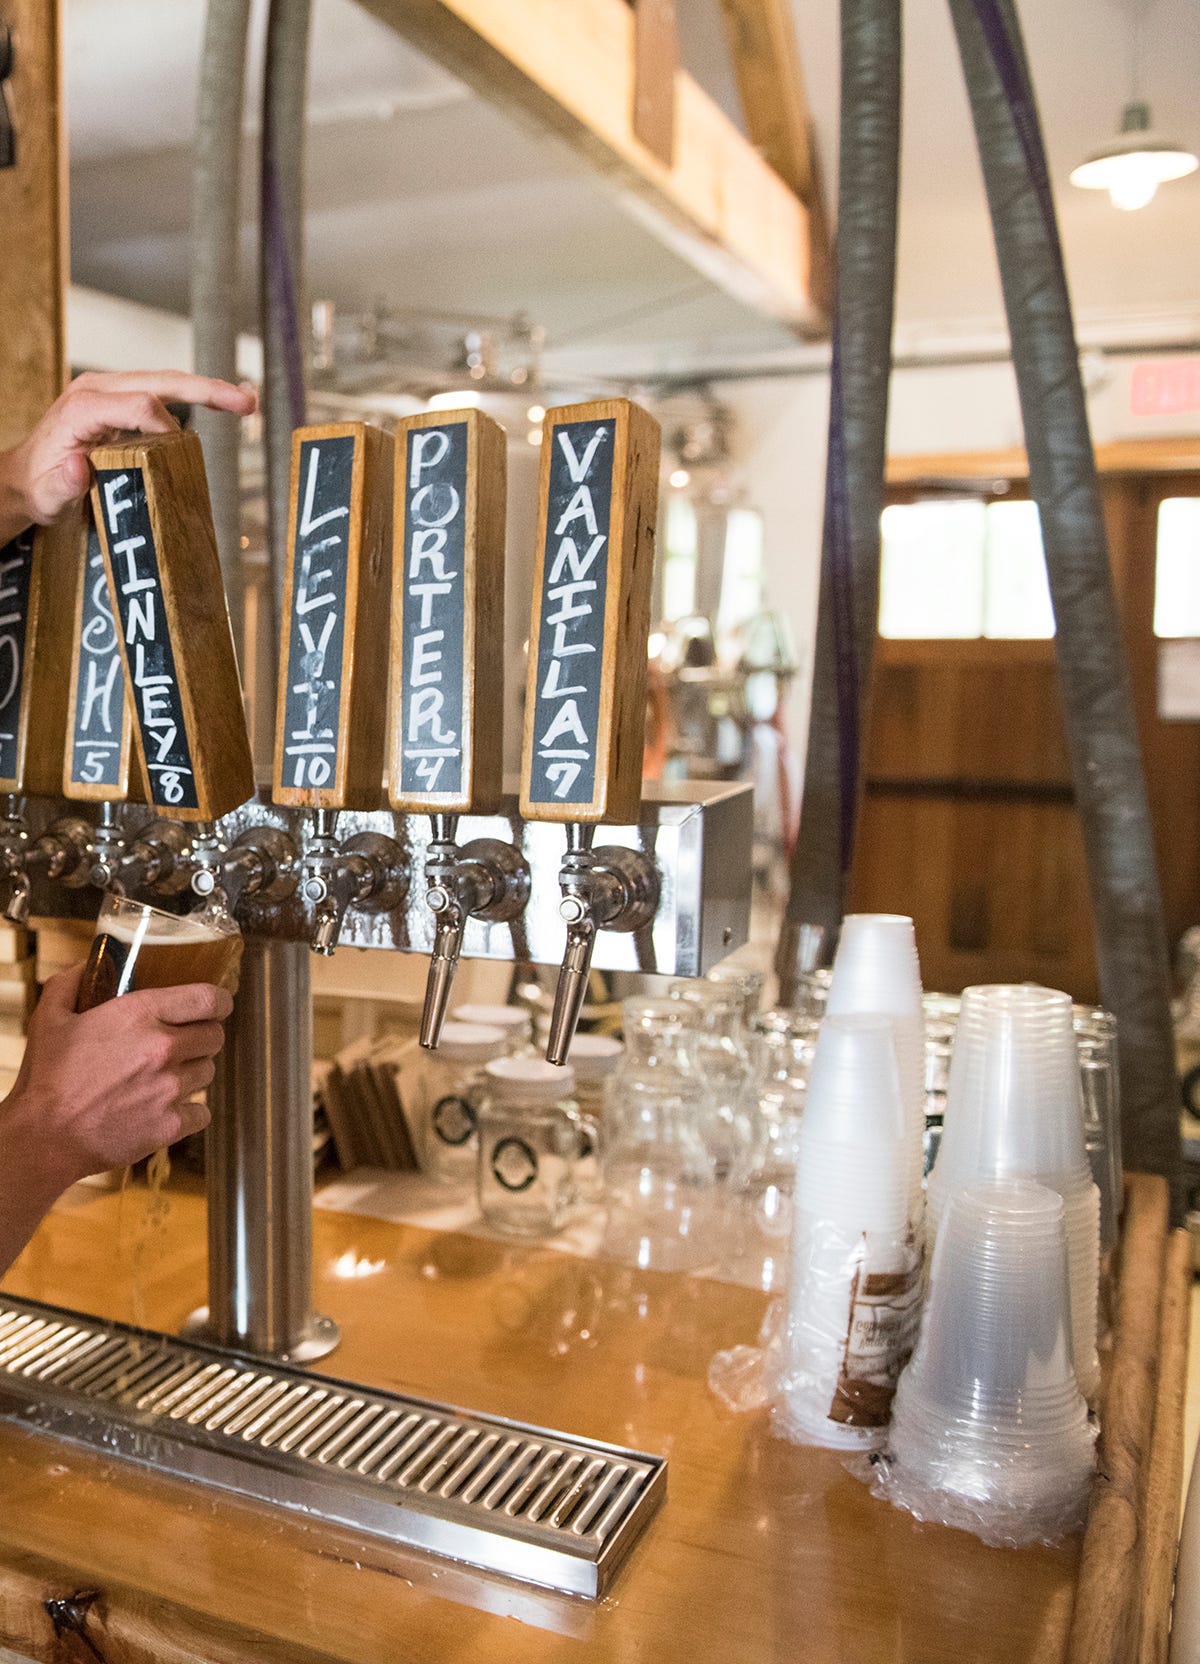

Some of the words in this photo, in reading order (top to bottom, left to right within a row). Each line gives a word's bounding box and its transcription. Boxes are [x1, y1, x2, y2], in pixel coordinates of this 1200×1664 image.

[291, 447, 349, 740] LEVI
[407, 430, 460, 744] PORTER
[539, 426, 609, 747] VANILLA
[103, 474, 178, 763] FINLEY
[79, 751, 111, 783] 5
[293, 756, 332, 788] 10
[414, 757, 445, 792] 4
[544, 761, 582, 798] 7
[158, 770, 186, 803] 8
